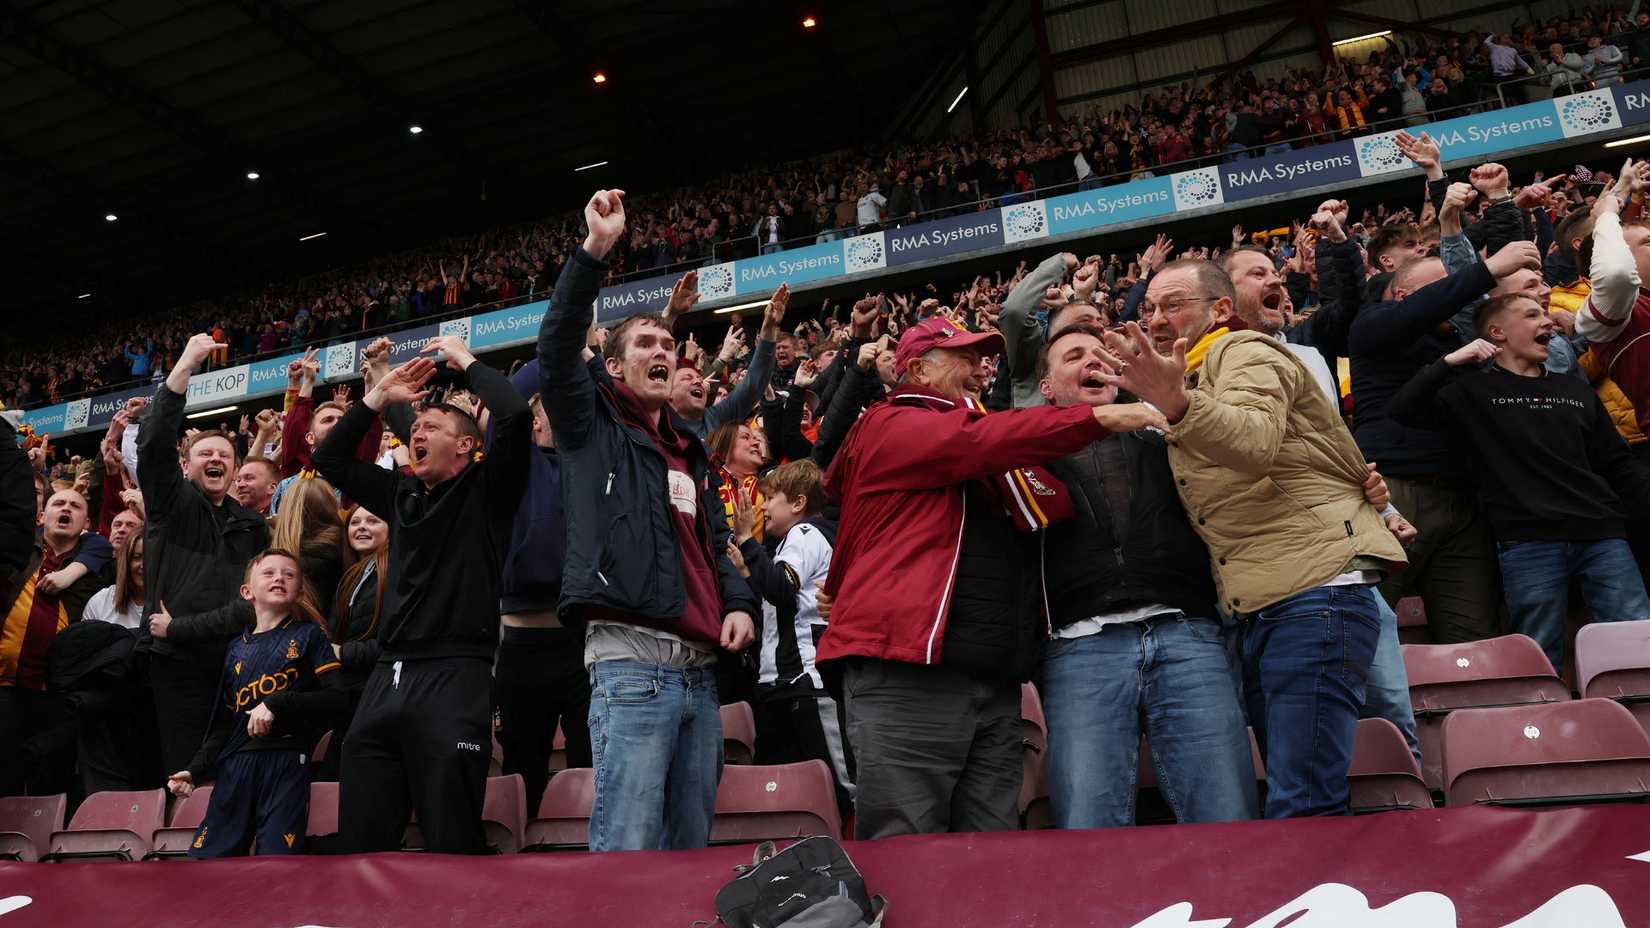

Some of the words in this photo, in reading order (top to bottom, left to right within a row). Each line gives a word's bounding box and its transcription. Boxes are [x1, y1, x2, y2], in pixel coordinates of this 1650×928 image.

[1430, 130, 1466, 148] MA
[1468, 116, 1553, 142] Systems
[1228, 168, 1273, 188] RMA
[1276, 154, 1353, 179] Systems
[1054, 202, 1094, 221] RMA
[1098, 189, 1169, 214] Systems
[892, 236, 930, 253] RMA
[932, 221, 999, 246] Systems
[741, 265, 776, 282] RMA
[779, 253, 841, 277] Systems
[603, 292, 635, 309] RMA
[637, 287, 673, 304] Syste
[476, 320, 505, 336] RMA
[507, 313, 546, 330] Syste
[187, 380, 212, 396] THE
[216, 373, 245, 393] KOP
[252, 368, 278, 383] RMA
[92, 401, 115, 415] RMA
[1491, 397, 1531, 405] TOMMY
[457, 742, 481, 751] mitre
